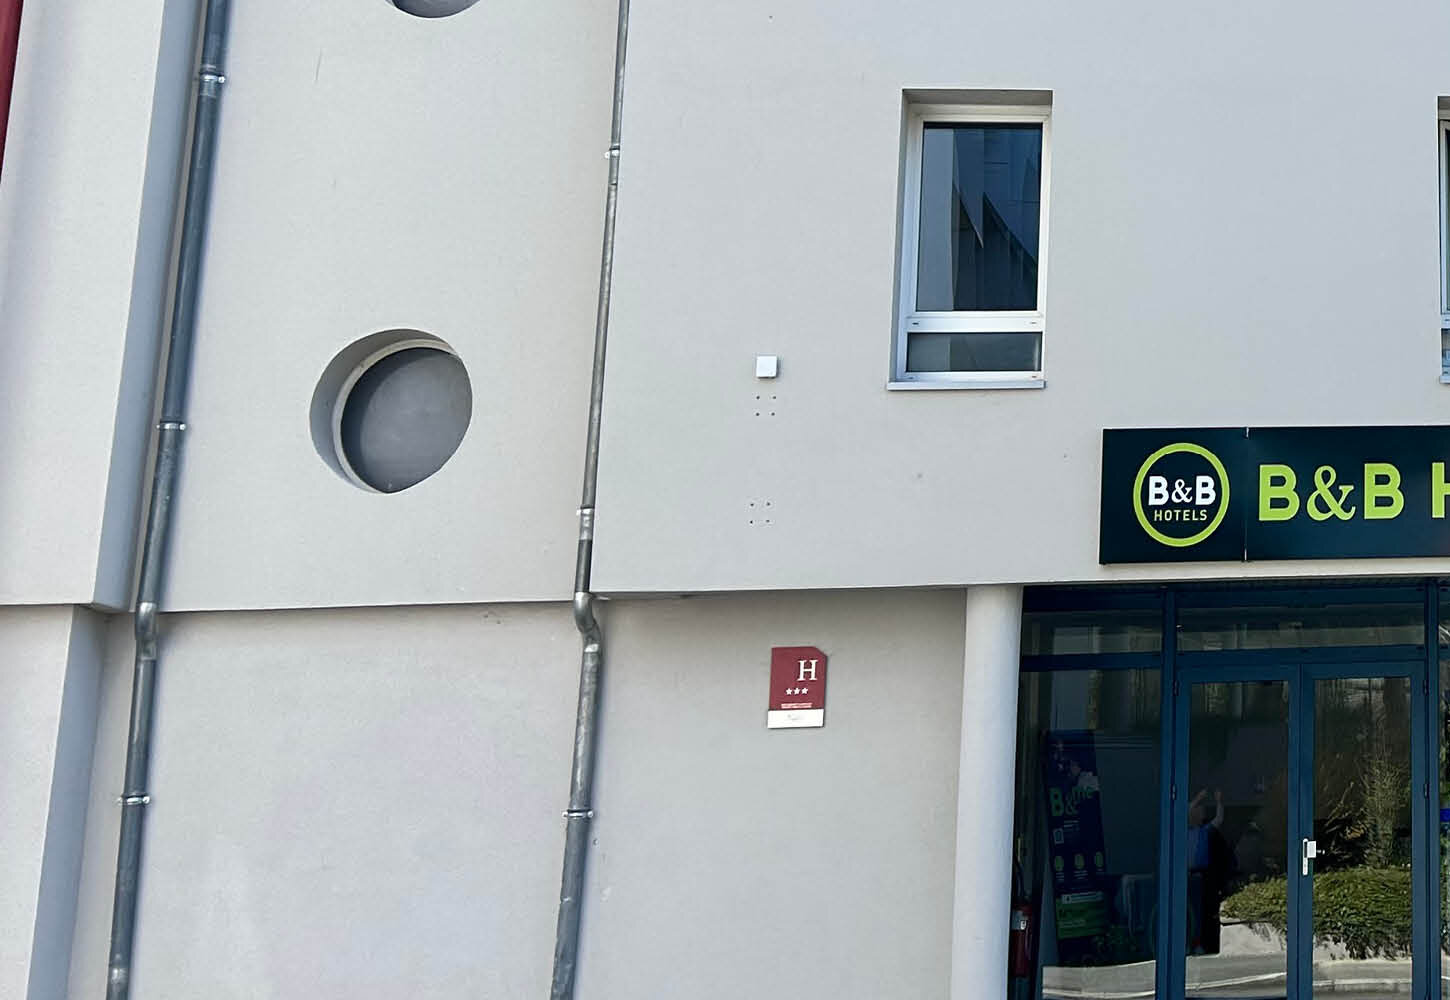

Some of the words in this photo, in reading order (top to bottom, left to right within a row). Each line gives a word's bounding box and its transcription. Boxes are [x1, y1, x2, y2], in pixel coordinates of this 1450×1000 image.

[1148, 475, 1216, 506] B&B
[1258, 463, 1406, 523] B&B
[1154, 509, 1208, 522] HOTELS
[797, 659, 819, 682] H
